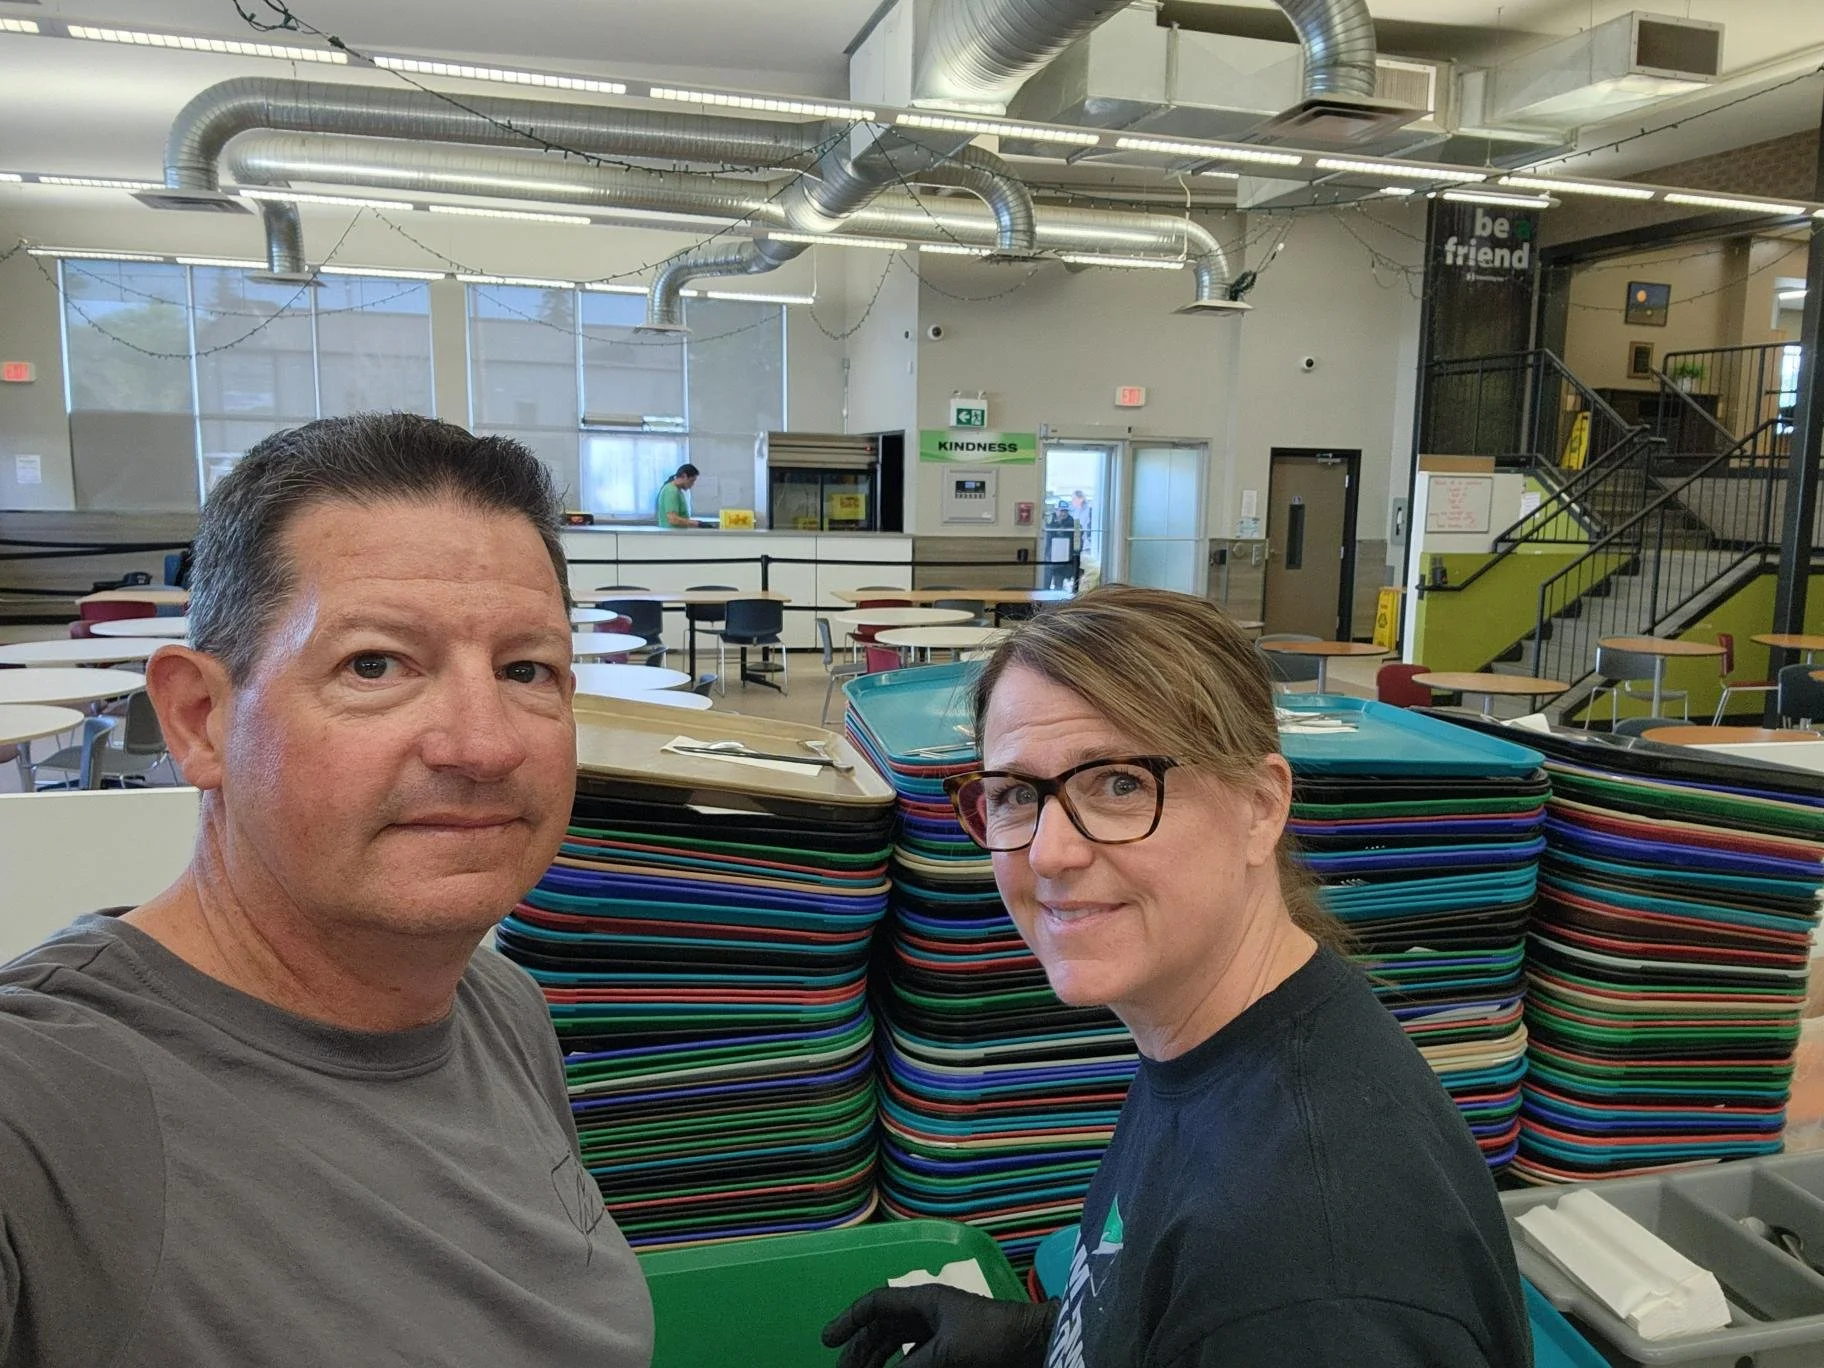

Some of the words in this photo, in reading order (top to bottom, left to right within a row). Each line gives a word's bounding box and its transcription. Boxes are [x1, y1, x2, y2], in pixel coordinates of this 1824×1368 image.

[1475, 208, 1510, 239] be
[1445, 236, 1530, 269] friend
[938, 441, 1018, 453] KINDNESS
